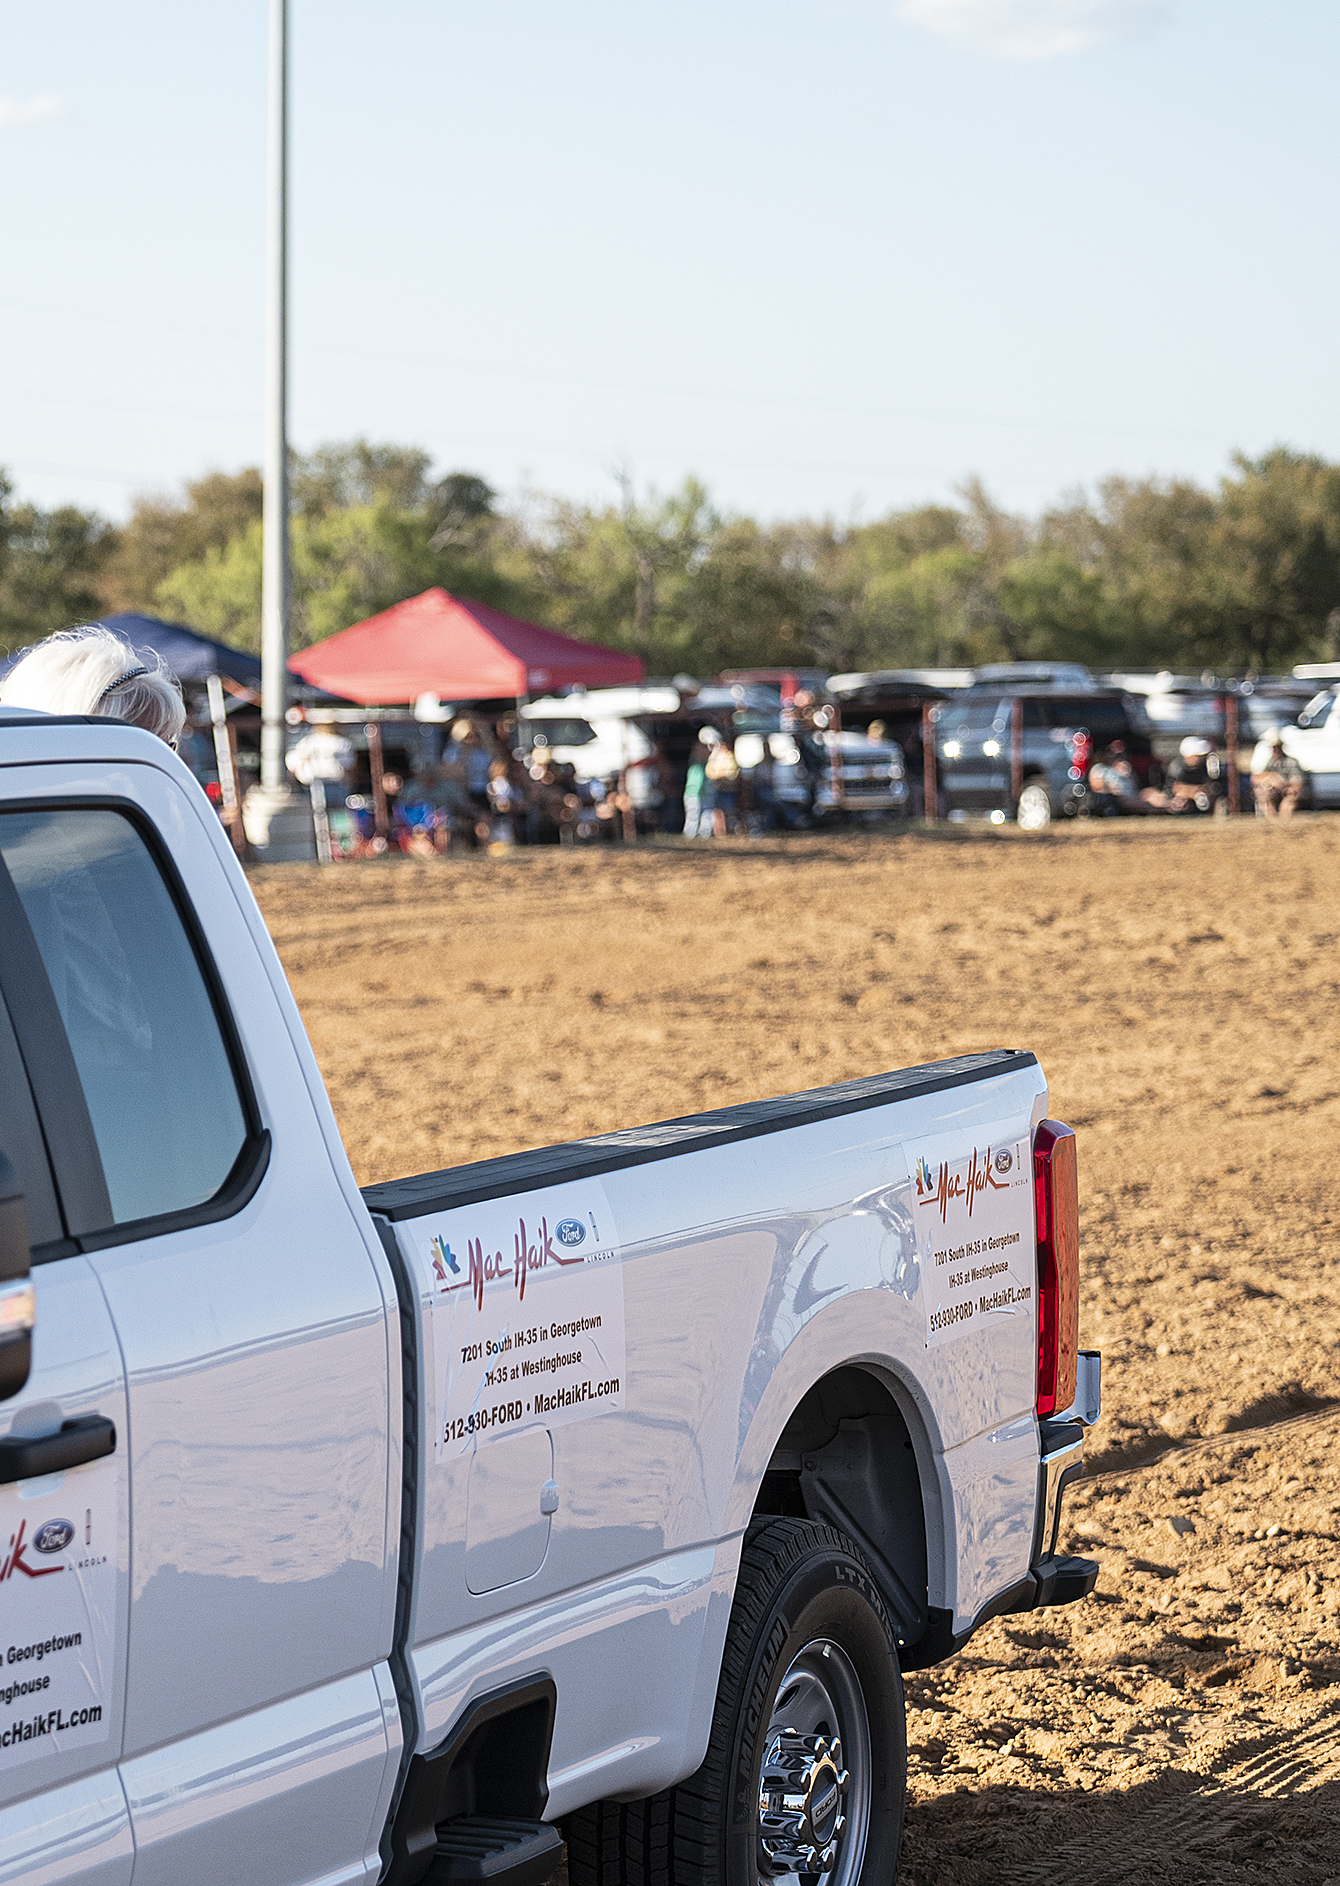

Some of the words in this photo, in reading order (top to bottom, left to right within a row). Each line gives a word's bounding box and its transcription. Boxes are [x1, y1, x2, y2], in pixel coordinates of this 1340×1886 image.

[919, 1161, 965, 1224] Mac
[966, 1146, 1010, 1218] Haik
[441, 1237, 512, 1312] Mac
[514, 1216, 584, 1301] Haik
[586, 1251, 615, 1263] LINCOLN
[934, 1250, 948, 1266] 7201
[948, 1245, 965, 1262] South
[981, 1239, 987, 1252] in
[988, 1232, 1020, 1250] Georgetown
[964, 1270, 970, 1284] at
[971, 1261, 1008, 1279] Westinghouse
[980, 1286, 1031, 1314] MacHaikFL.com
[461, 1342, 483, 1364] 7201
[486, 1336, 512, 1356] South
[514, 1327, 538, 1349] IH-35
[539, 1326, 548, 1342] in
[550, 1315, 602, 1338] Georgetown
[510, 1363, 520, 1381] at
[521, 1350, 582, 1377] Westinghouse
[443, 1399, 523, 1443] 512-930-FORD
[534, 1378, 620, 1414] MacHaikFL.com
[834, 1565, 866, 1592] LTX
[7, 1632, 82, 1664] Georgetown
[738, 1615, 789, 1781] MICHELIN
[815, 1791, 836, 1818] FORD
